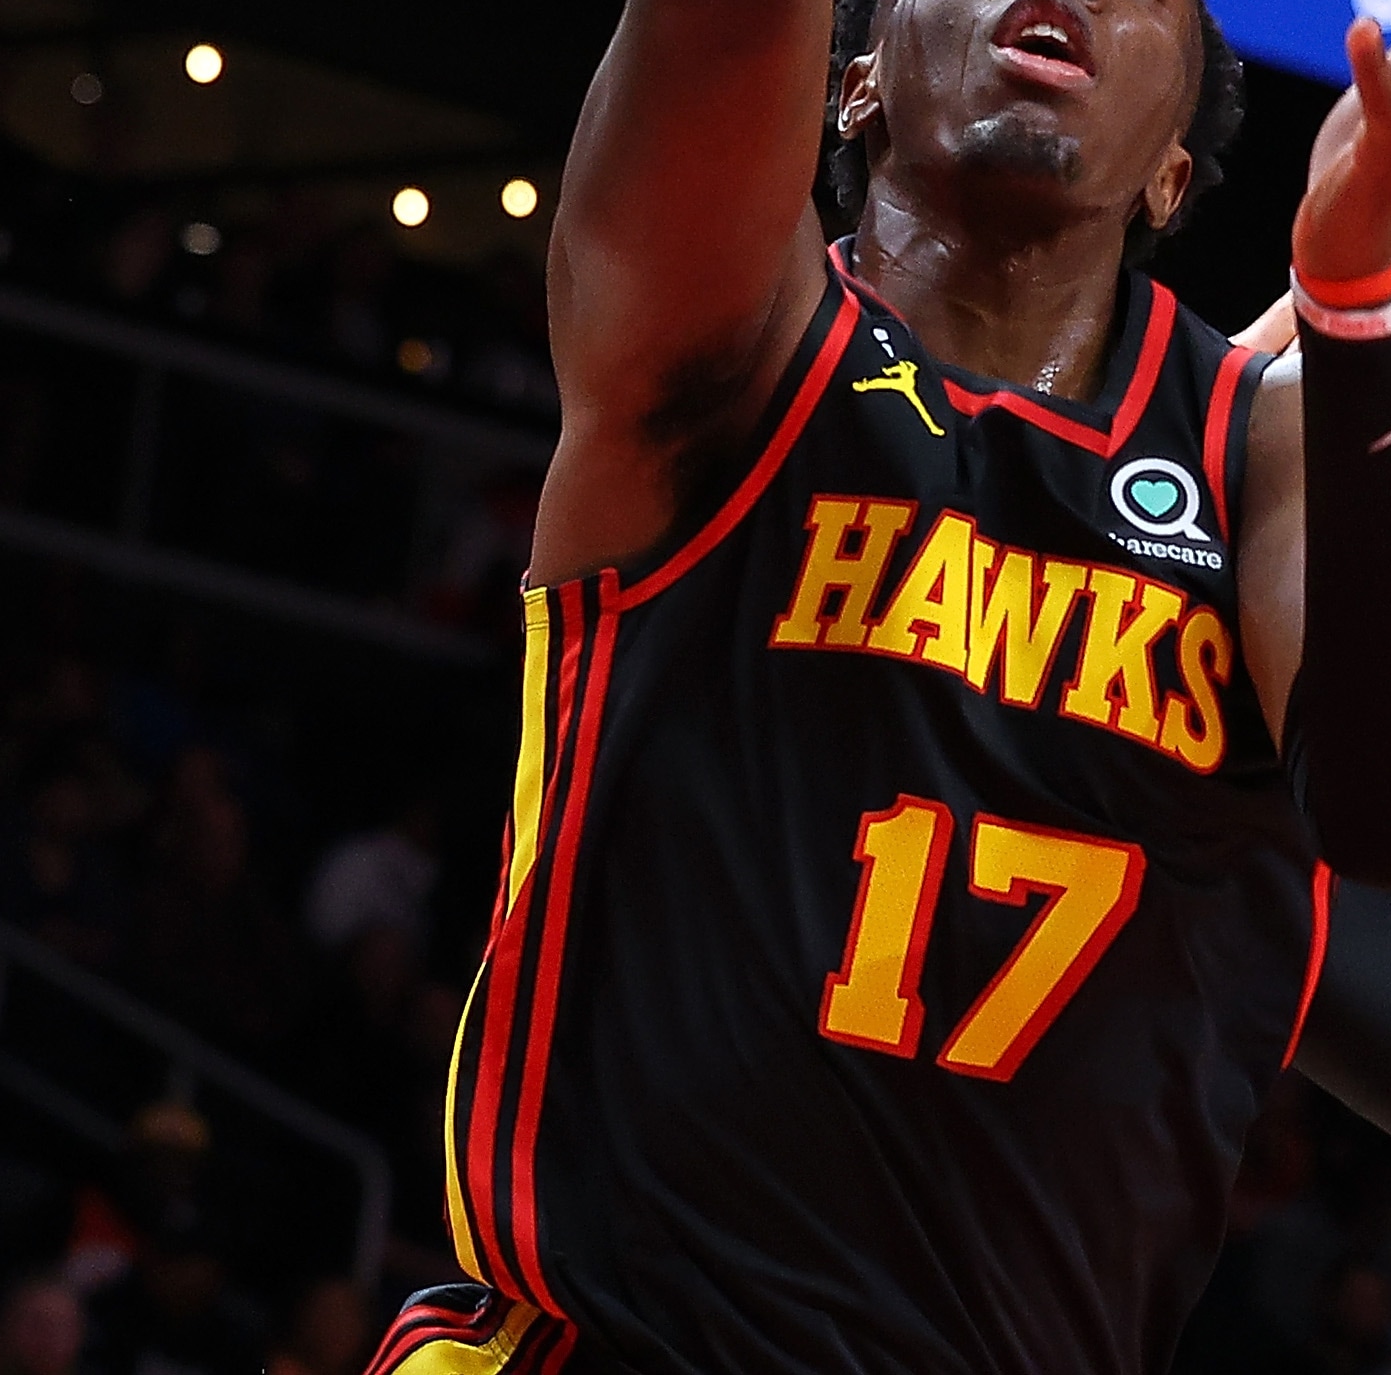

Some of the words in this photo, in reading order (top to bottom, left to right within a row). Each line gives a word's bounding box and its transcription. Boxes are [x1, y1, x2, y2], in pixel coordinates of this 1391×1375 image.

[769, 492, 1234, 775] HAWKS
[1108, 532, 1223, 570] arecare
[818, 793, 1147, 1082] 17
